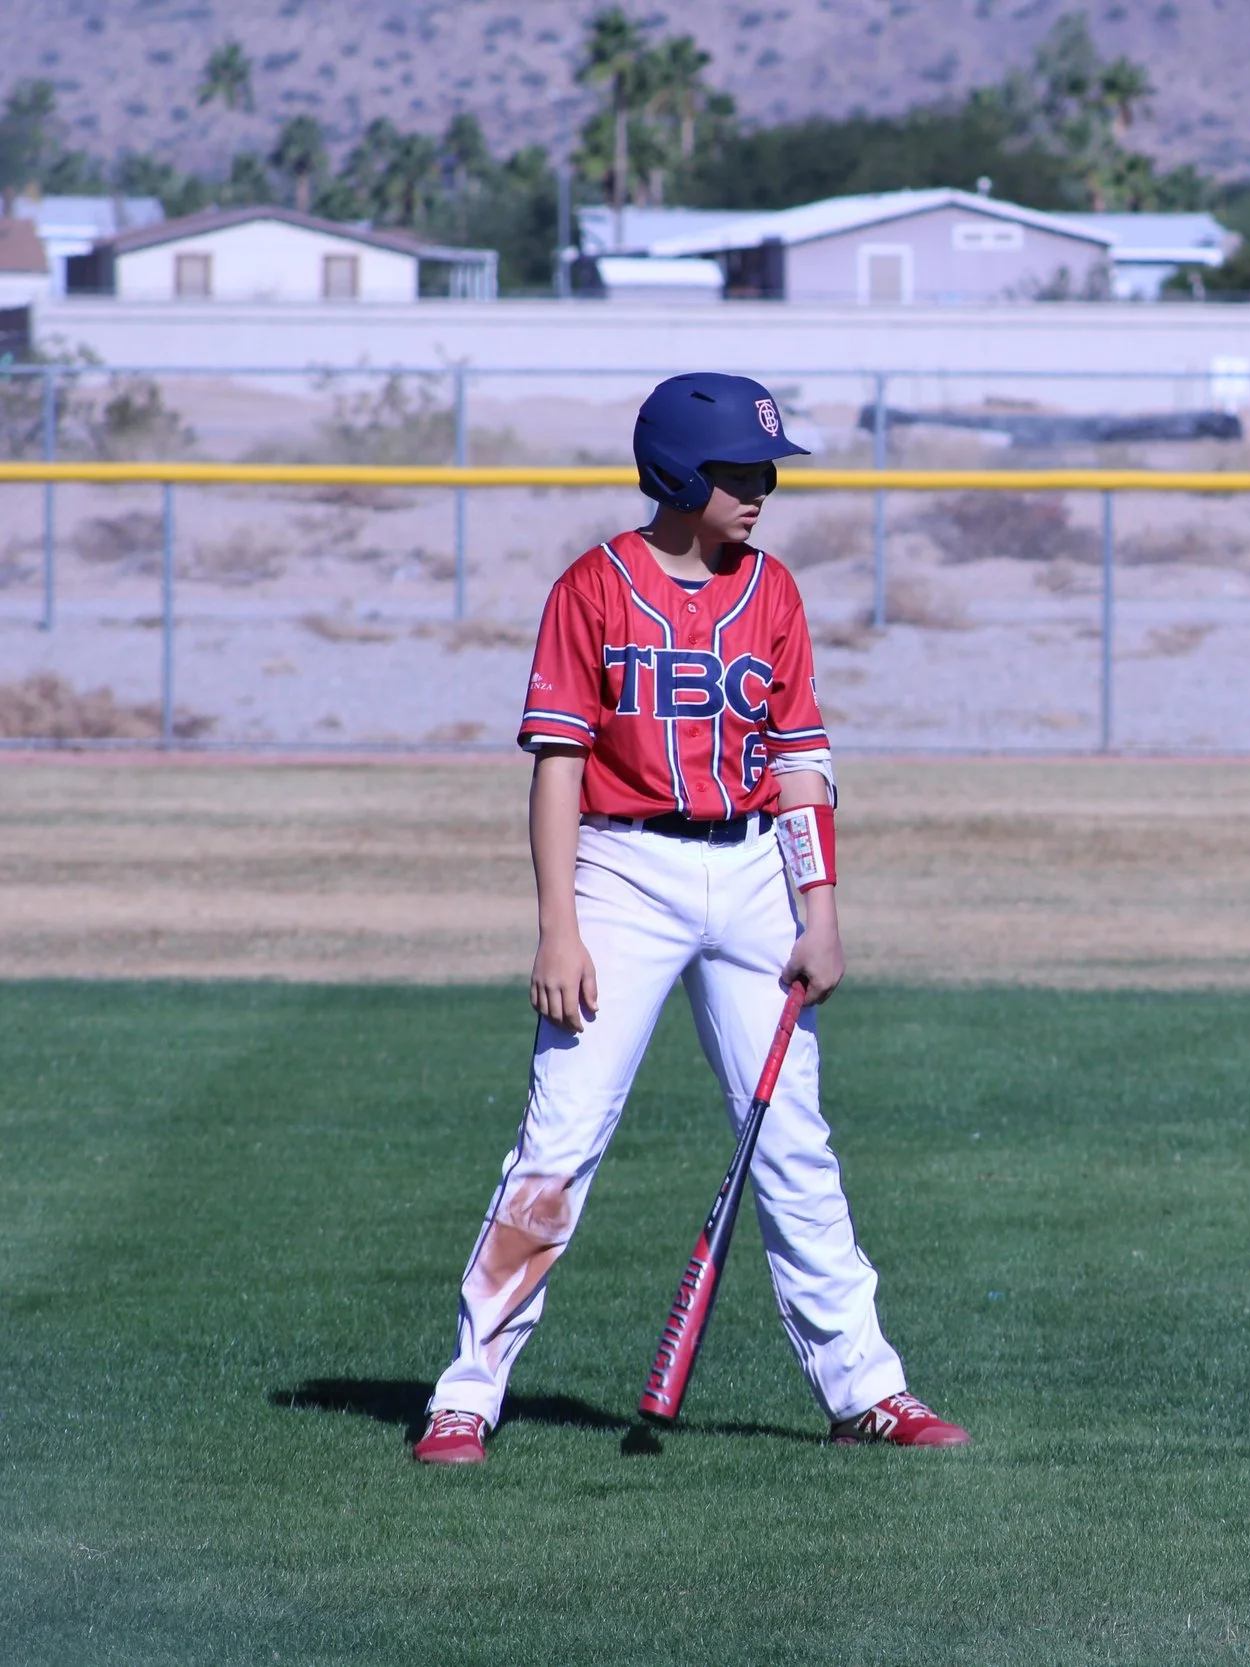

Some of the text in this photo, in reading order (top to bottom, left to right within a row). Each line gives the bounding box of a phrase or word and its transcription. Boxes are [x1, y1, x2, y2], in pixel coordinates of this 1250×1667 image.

[603, 643, 773, 723] TBC
[741, 731, 767, 792] 6
[643, 1255, 708, 1406] marucci
